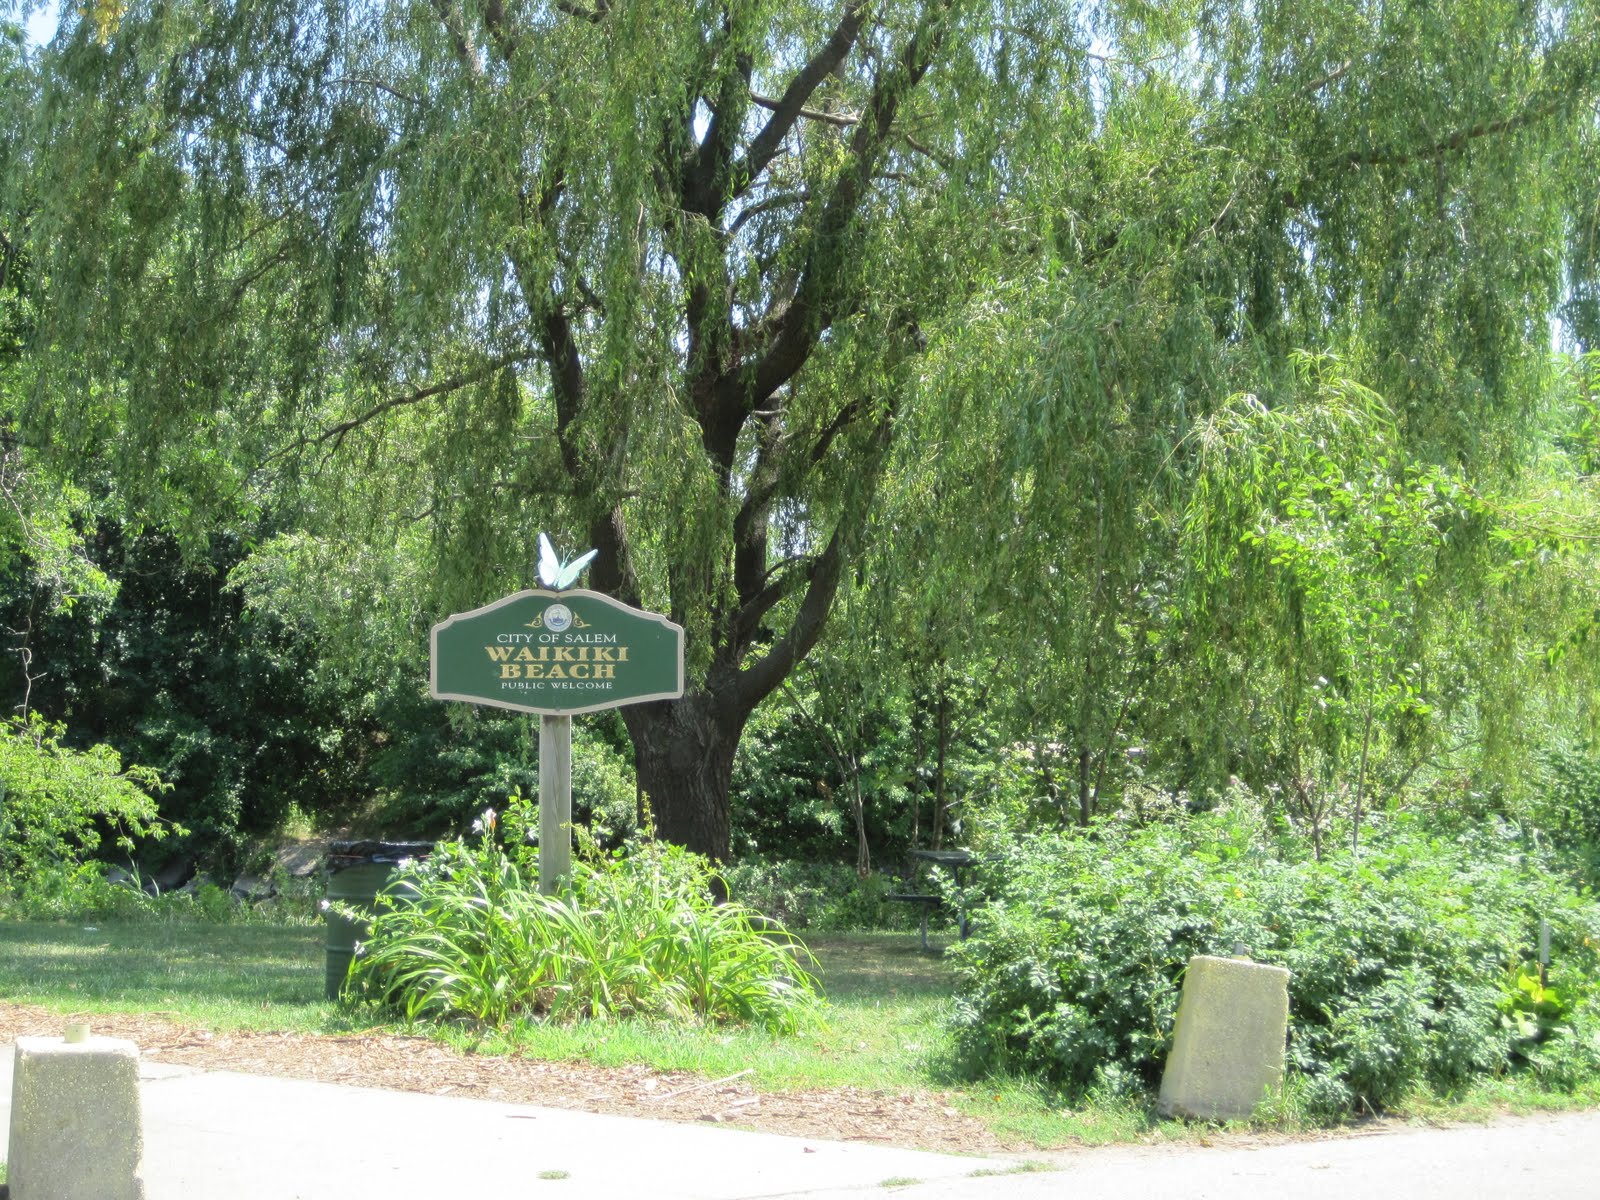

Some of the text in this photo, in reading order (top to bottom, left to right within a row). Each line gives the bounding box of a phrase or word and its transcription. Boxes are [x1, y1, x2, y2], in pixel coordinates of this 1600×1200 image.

[496, 633, 618, 643] CITY OF SALEM
[484, 646, 630, 662] WAIKIKI
[499, 663, 617, 679] BEACH
[501, 681, 614, 690] PUBLIC WELCOME
